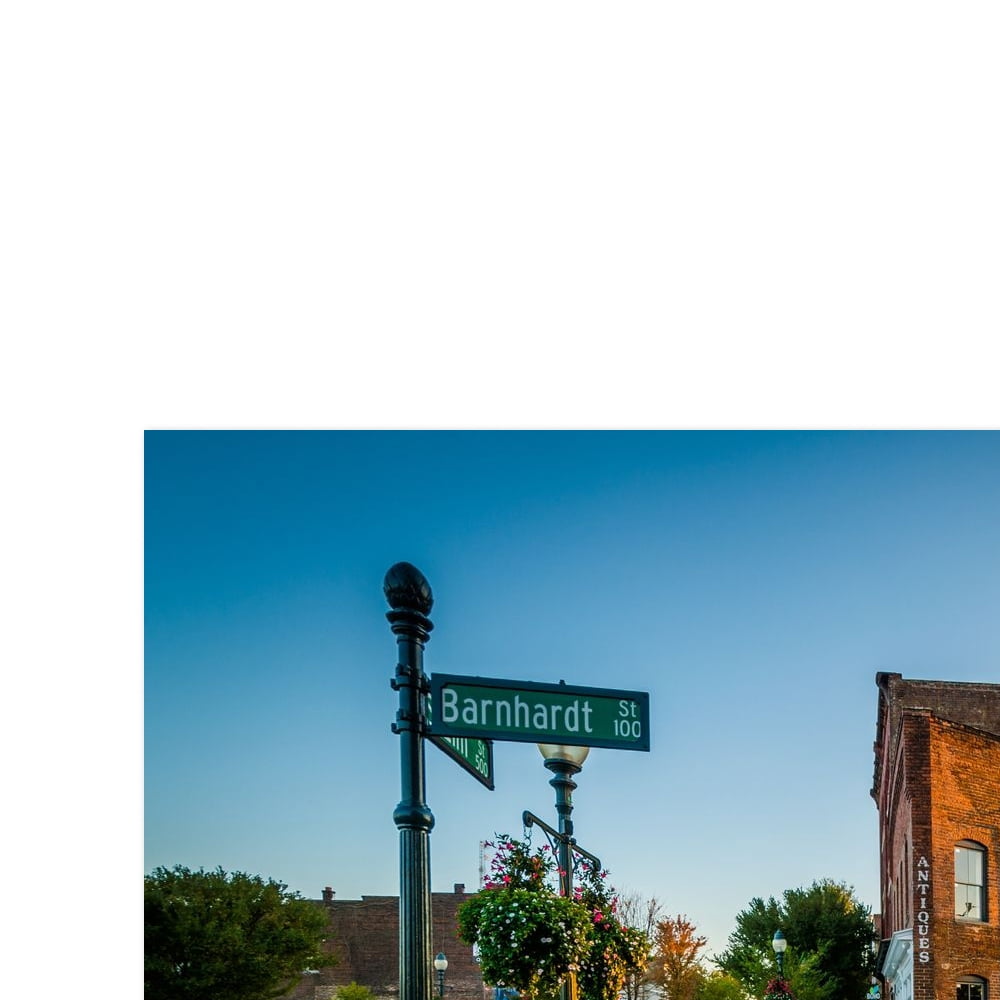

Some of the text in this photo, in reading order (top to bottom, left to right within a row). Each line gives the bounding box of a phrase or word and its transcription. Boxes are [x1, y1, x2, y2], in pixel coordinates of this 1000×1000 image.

[441, 688, 593, 733] Barnhardt
[618, 700, 637, 718] St
[614, 719, 641, 738] 100
[475, 754, 489, 778] 500
[917, 856, 930, 963] ANTIQUES
